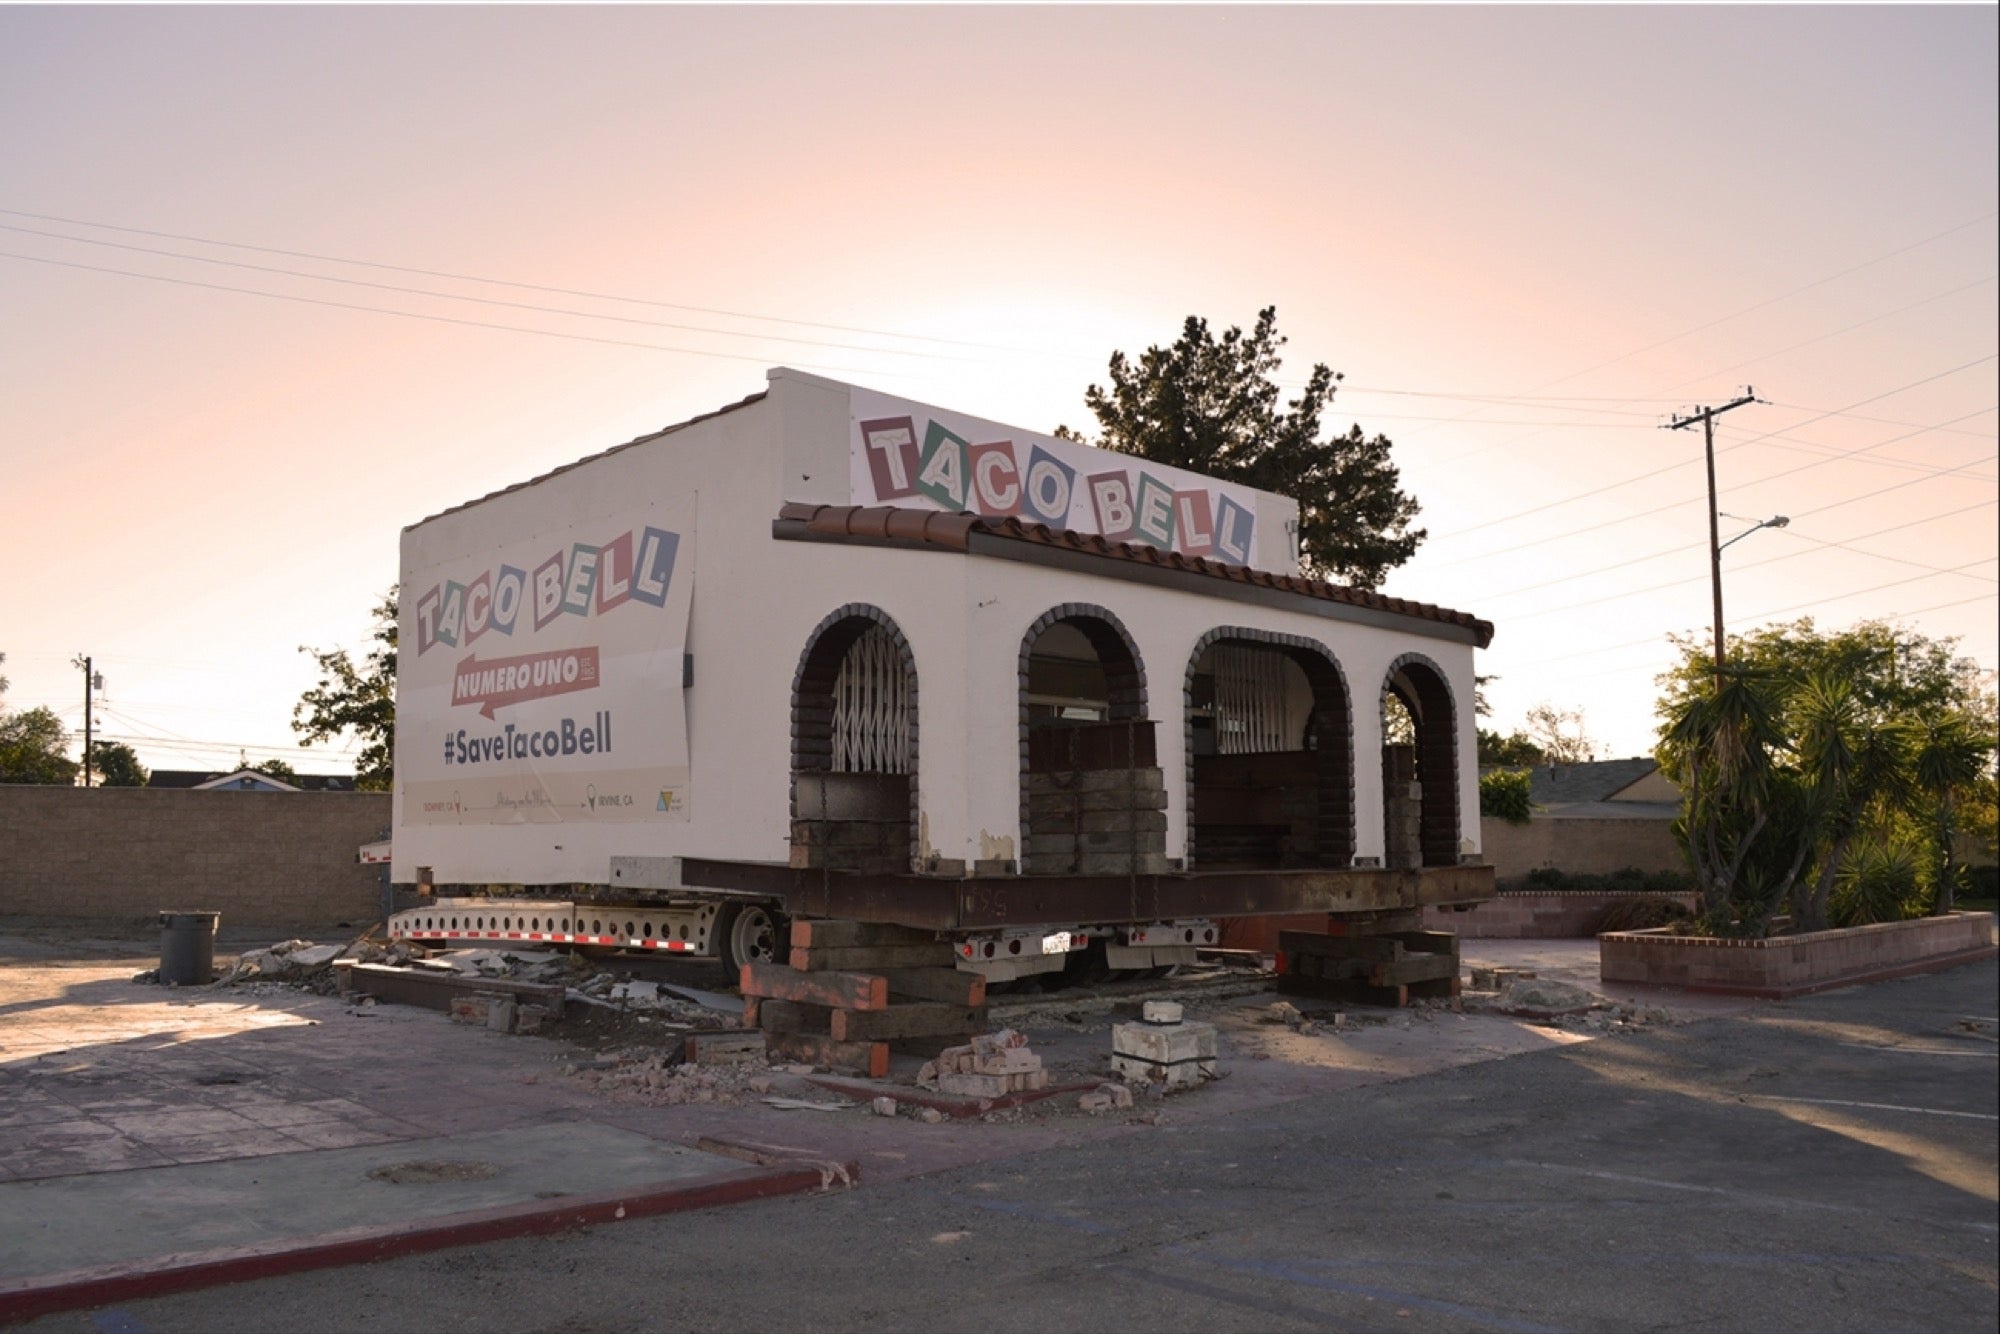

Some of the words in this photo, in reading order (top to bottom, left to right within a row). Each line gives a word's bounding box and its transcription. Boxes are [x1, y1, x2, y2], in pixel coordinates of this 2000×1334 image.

[867, 425, 1071, 522] TACO
[1094, 477, 1247, 561] BELL
[419, 572, 521, 647] TACO
[535, 535, 666, 623] BELL
[457, 664, 531, 699] NUMERO
[533, 656, 578, 687] UNO
[444, 711, 612, 765] #SaveTacoBell
[623, 794, 634, 806] CA
